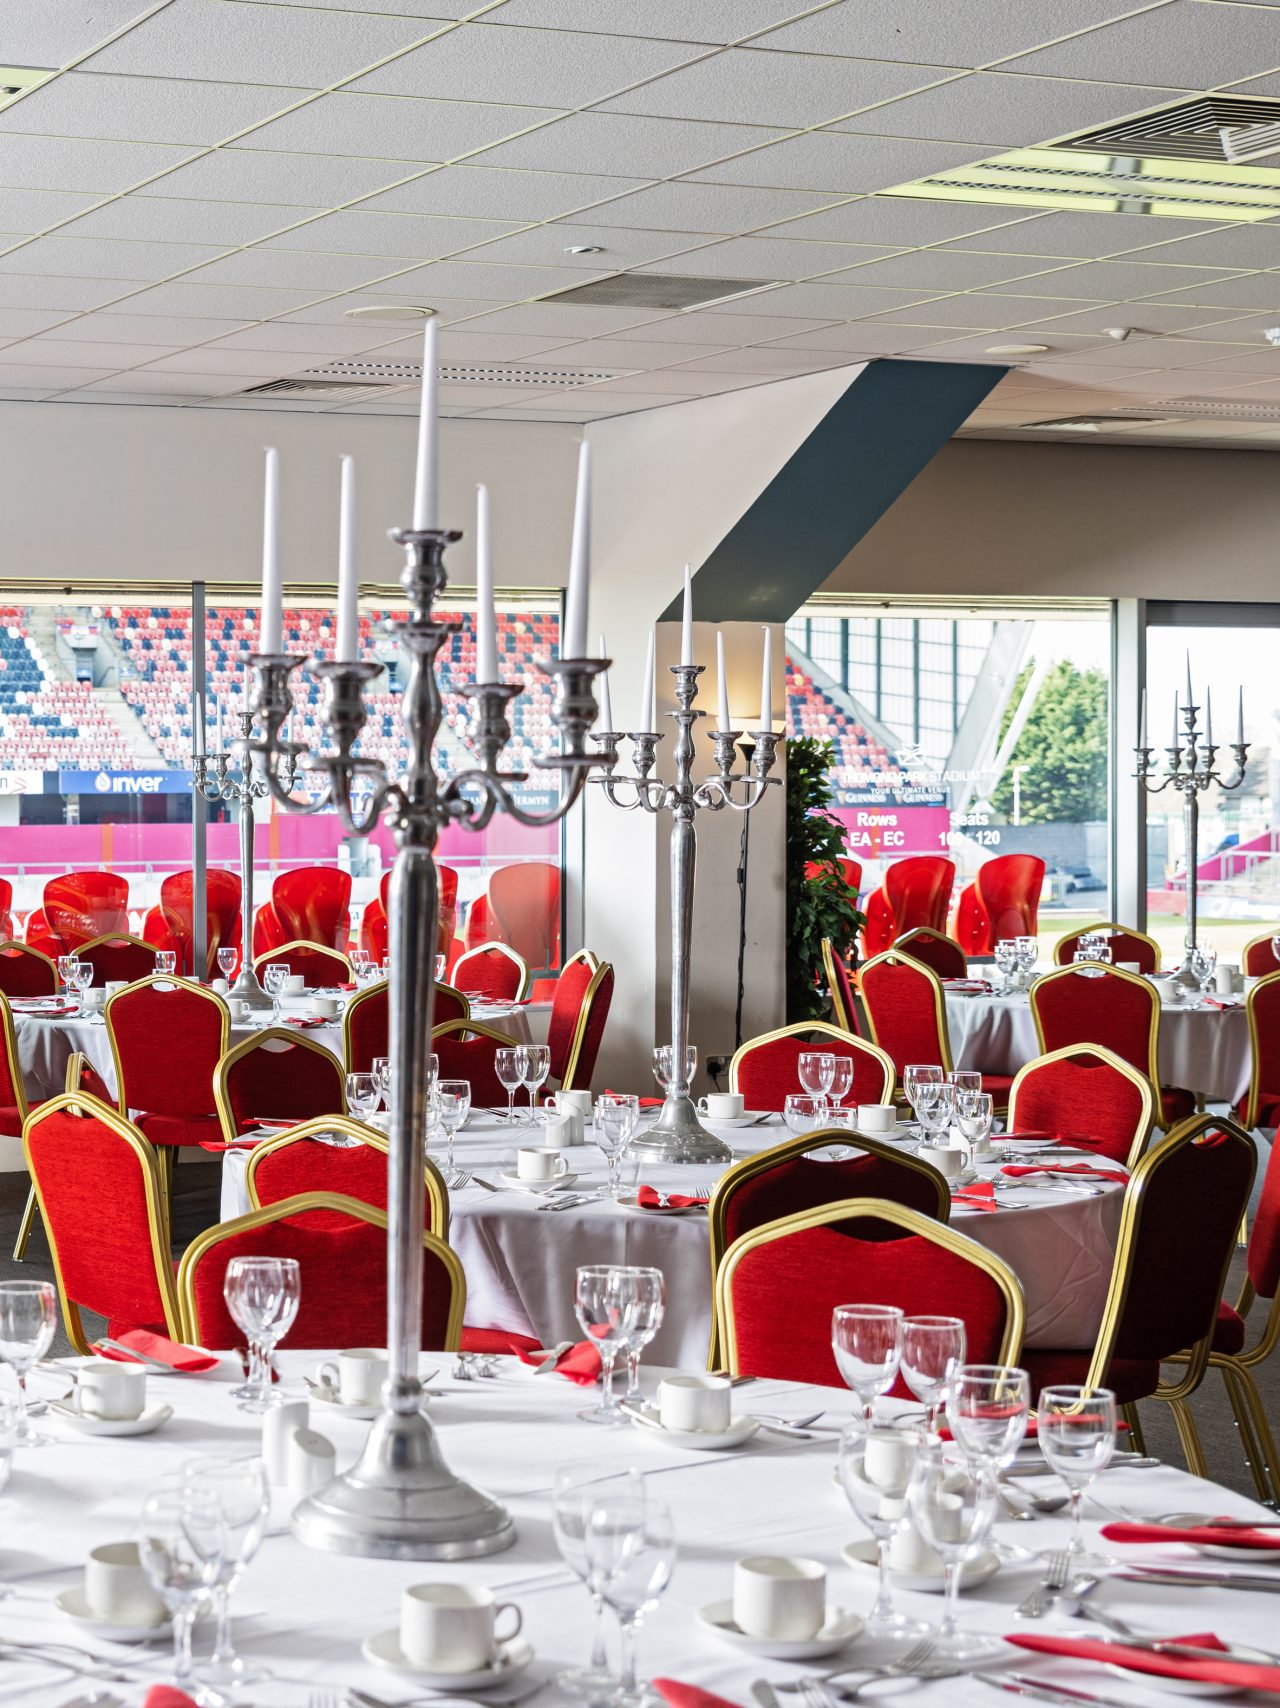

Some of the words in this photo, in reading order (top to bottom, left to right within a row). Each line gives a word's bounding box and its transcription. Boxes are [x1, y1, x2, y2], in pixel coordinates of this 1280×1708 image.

[111, 776, 163, 792] inver
[899, 771, 928, 783] PARK
[871, 786, 890, 795] YOUR
[857, 812, 898, 826] Rows
[949, 812, 989, 826] Seats
[850, 832, 871, 847] EA
[883, 831, 905, 846] EC
[975, 830, 1001, 845] 120
